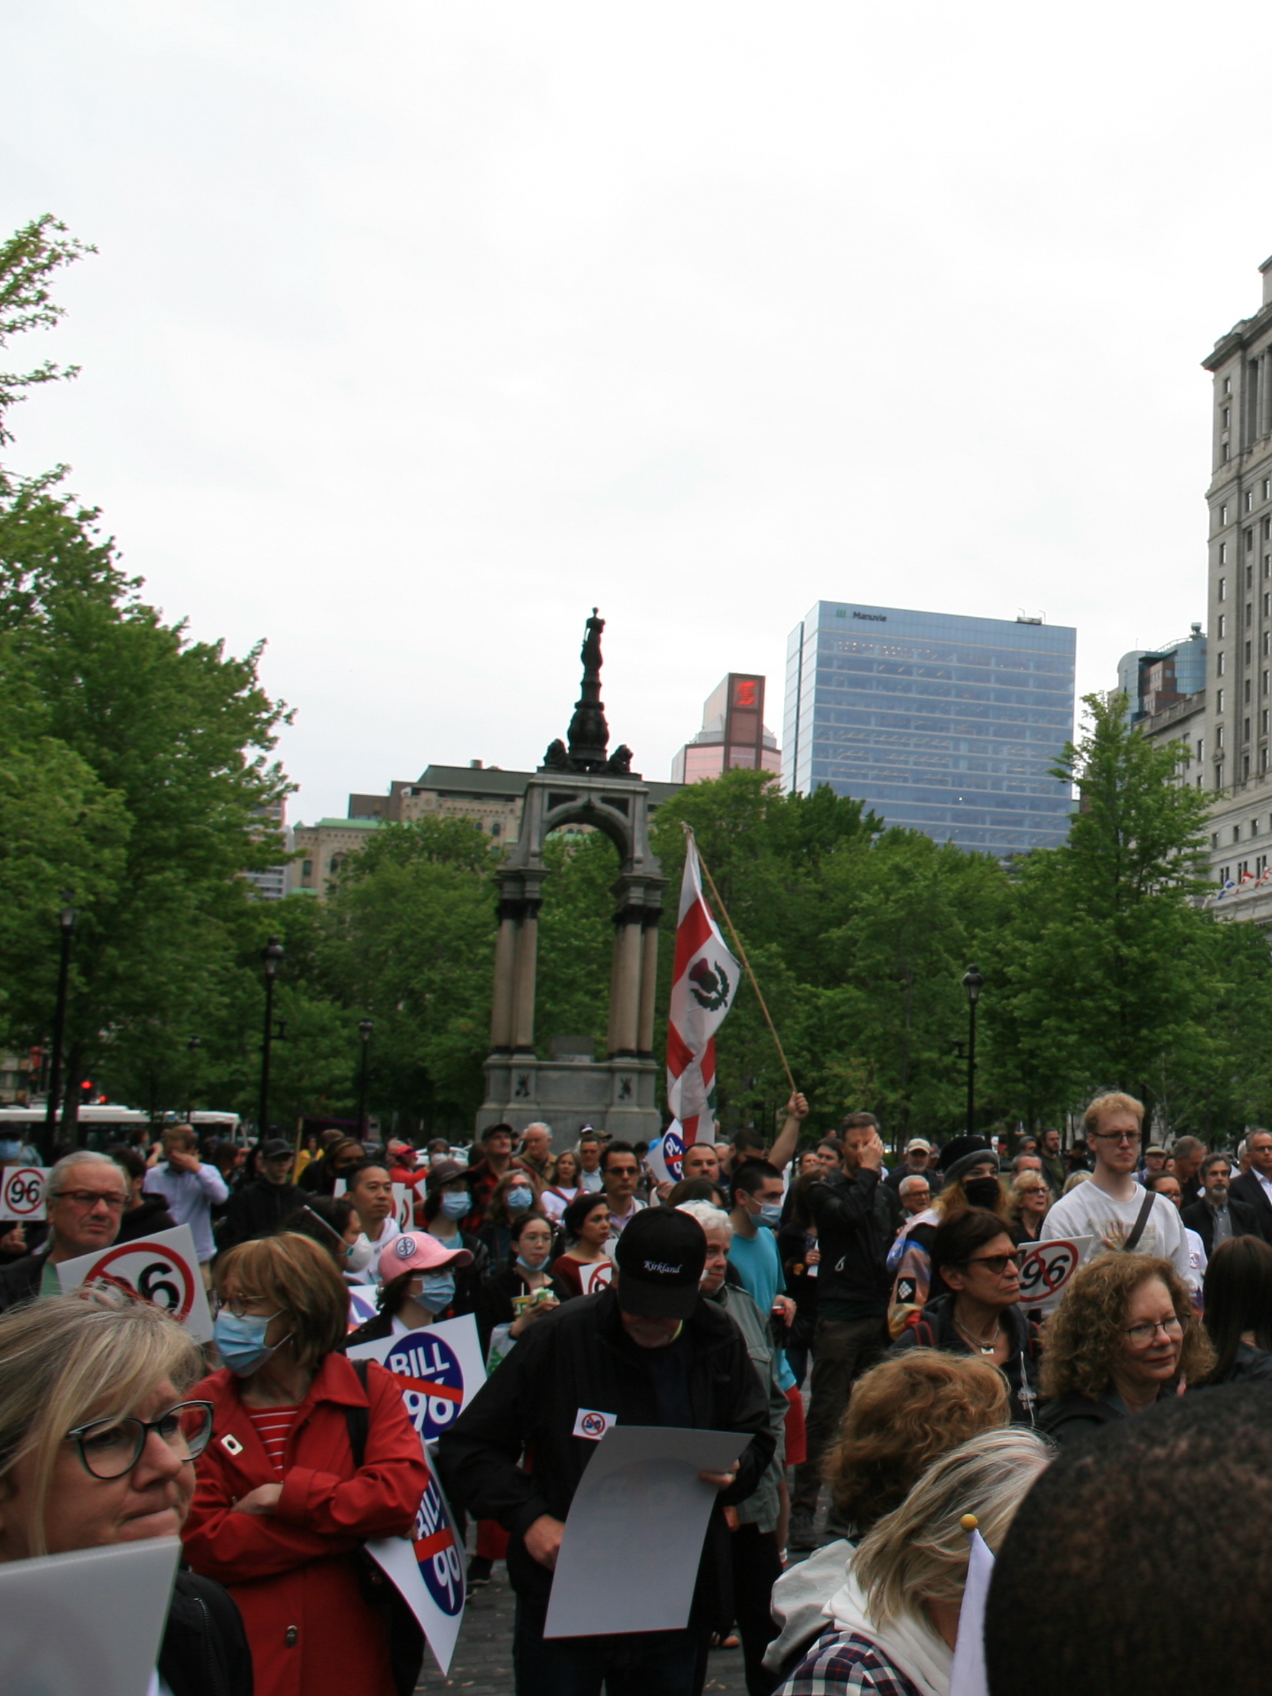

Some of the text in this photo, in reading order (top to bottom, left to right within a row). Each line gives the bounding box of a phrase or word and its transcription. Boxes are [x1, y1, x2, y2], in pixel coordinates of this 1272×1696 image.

[11, 1180, 40, 1203] 96
[644, 1260, 682, 1274] Kirkland
[1019, 1254, 1070, 1290] 96
[390, 1342, 450, 1379] BILL
[402, 1376, 454, 1433] 96
